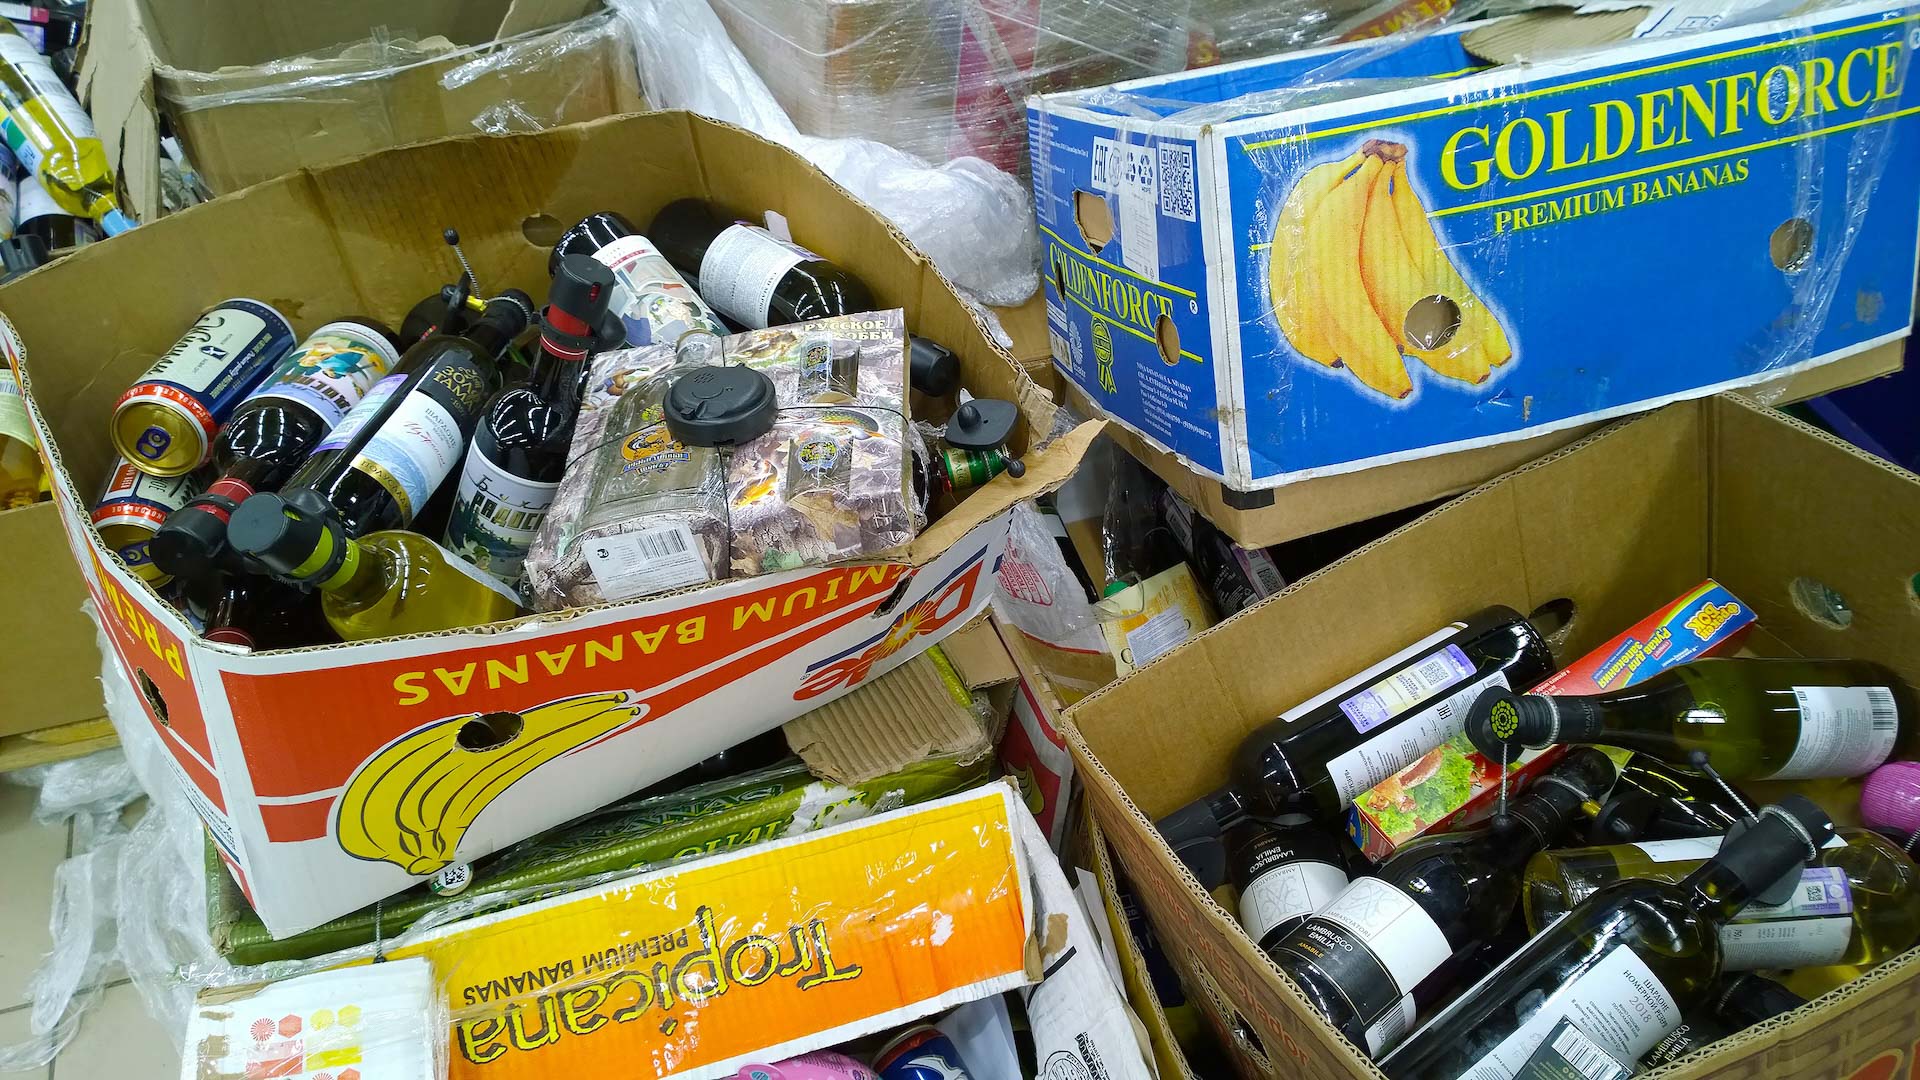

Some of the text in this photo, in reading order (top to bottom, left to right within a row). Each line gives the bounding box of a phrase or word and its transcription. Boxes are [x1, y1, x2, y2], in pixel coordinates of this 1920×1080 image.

[1440, 41, 1903, 192] GOLDENFORCE
[1494, 157, 1750, 235] PREMIUM BANANAS
[804, 319, 887, 332] РУССКОЕ
[471, 490, 546, 535] РАДОС
[1685, 602, 1718, 635] БОК
[1698, 602, 1741, 640] Фрекен
[394, 615, 706, 706] BANANAS
[1597, 641, 1644, 689] запекания
[1629, 627, 1672, 672] Рукав для
[1250, 849, 1295, 873] LAMBRUSCO
[1256, 846, 1281, 861] EMILIA
[1299, 941, 1325, 958] AMABILE
[1306, 923, 1353, 952] LAMBRUSCO
[1308, 931, 1337, 950] EMILIA
[457, 904, 862, 1064] Tropicana
[463, 927, 689, 1007] PREMIUM BANANAS
[1623, 969, 1669, 1029] НОМЕРНОЙ РЕЗЕР
[1629, 995, 1653, 1024] 2018
[1643, 978, 1670, 1013] ШАРДОНЕ
[1647, 1024, 1691, 1067] LAMBRUSCO
[1664, 1036, 1692, 1062] EMILIA
